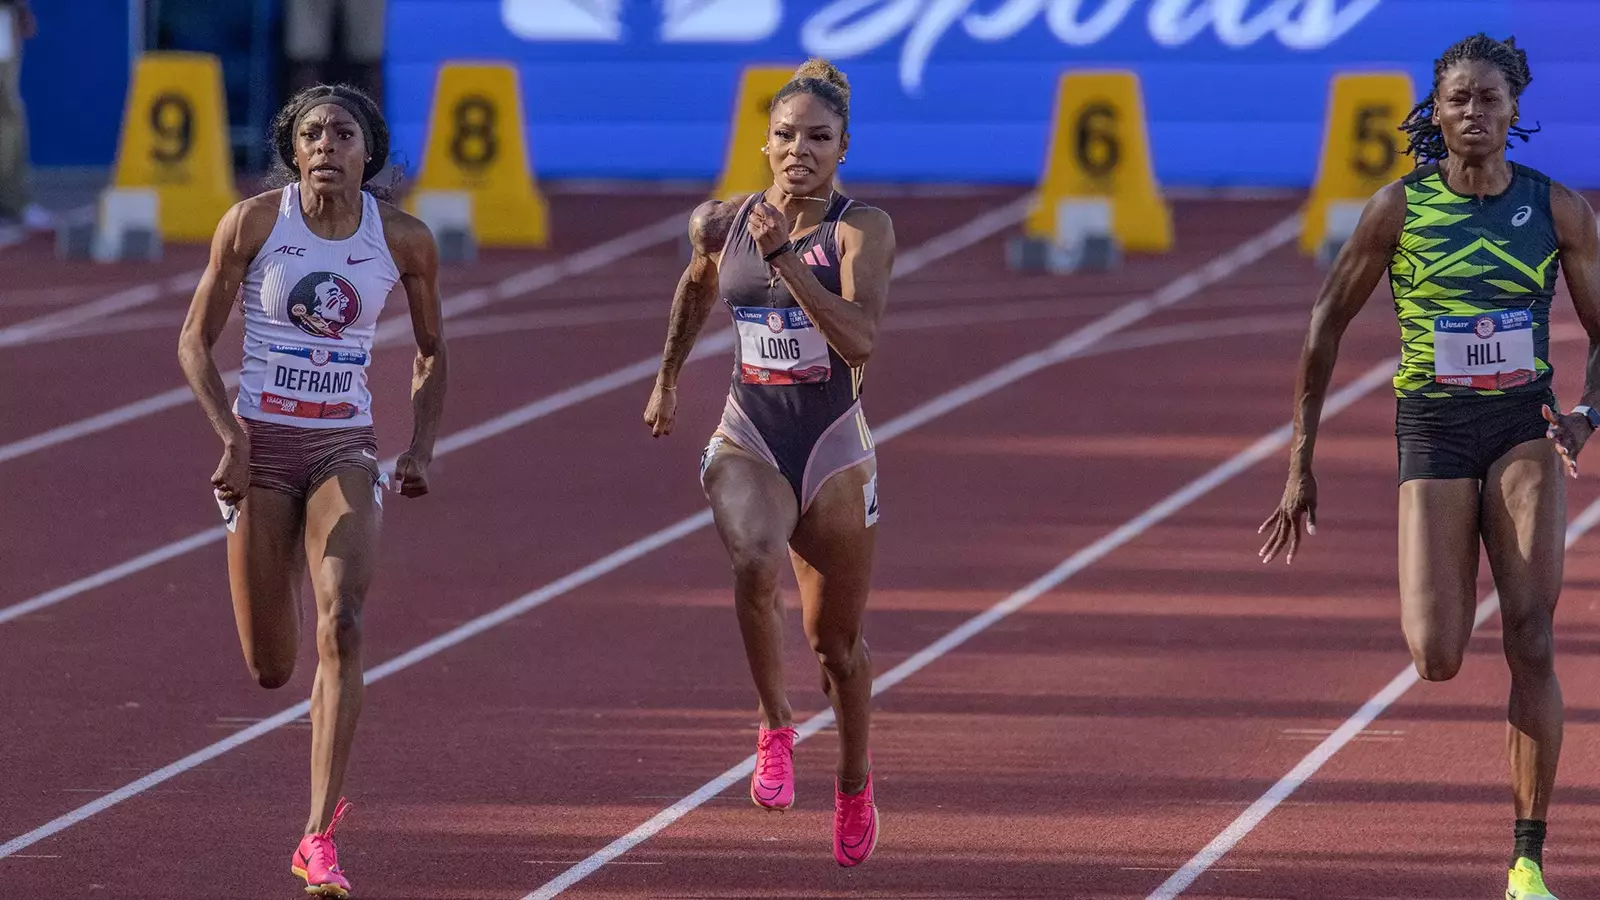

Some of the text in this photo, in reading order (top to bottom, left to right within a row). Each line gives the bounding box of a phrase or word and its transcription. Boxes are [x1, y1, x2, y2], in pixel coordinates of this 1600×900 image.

[149, 93, 194, 164] 9
[450, 95, 498, 170] 8
[1074, 101, 1121, 177] 6
[1351, 103, 1398, 178] 5
[273, 245, 307, 257] ACC
[760, 336, 800, 360] LONG
[1466, 341, 1507, 366] HILL
[274, 365, 353, 394] DEFRAND
